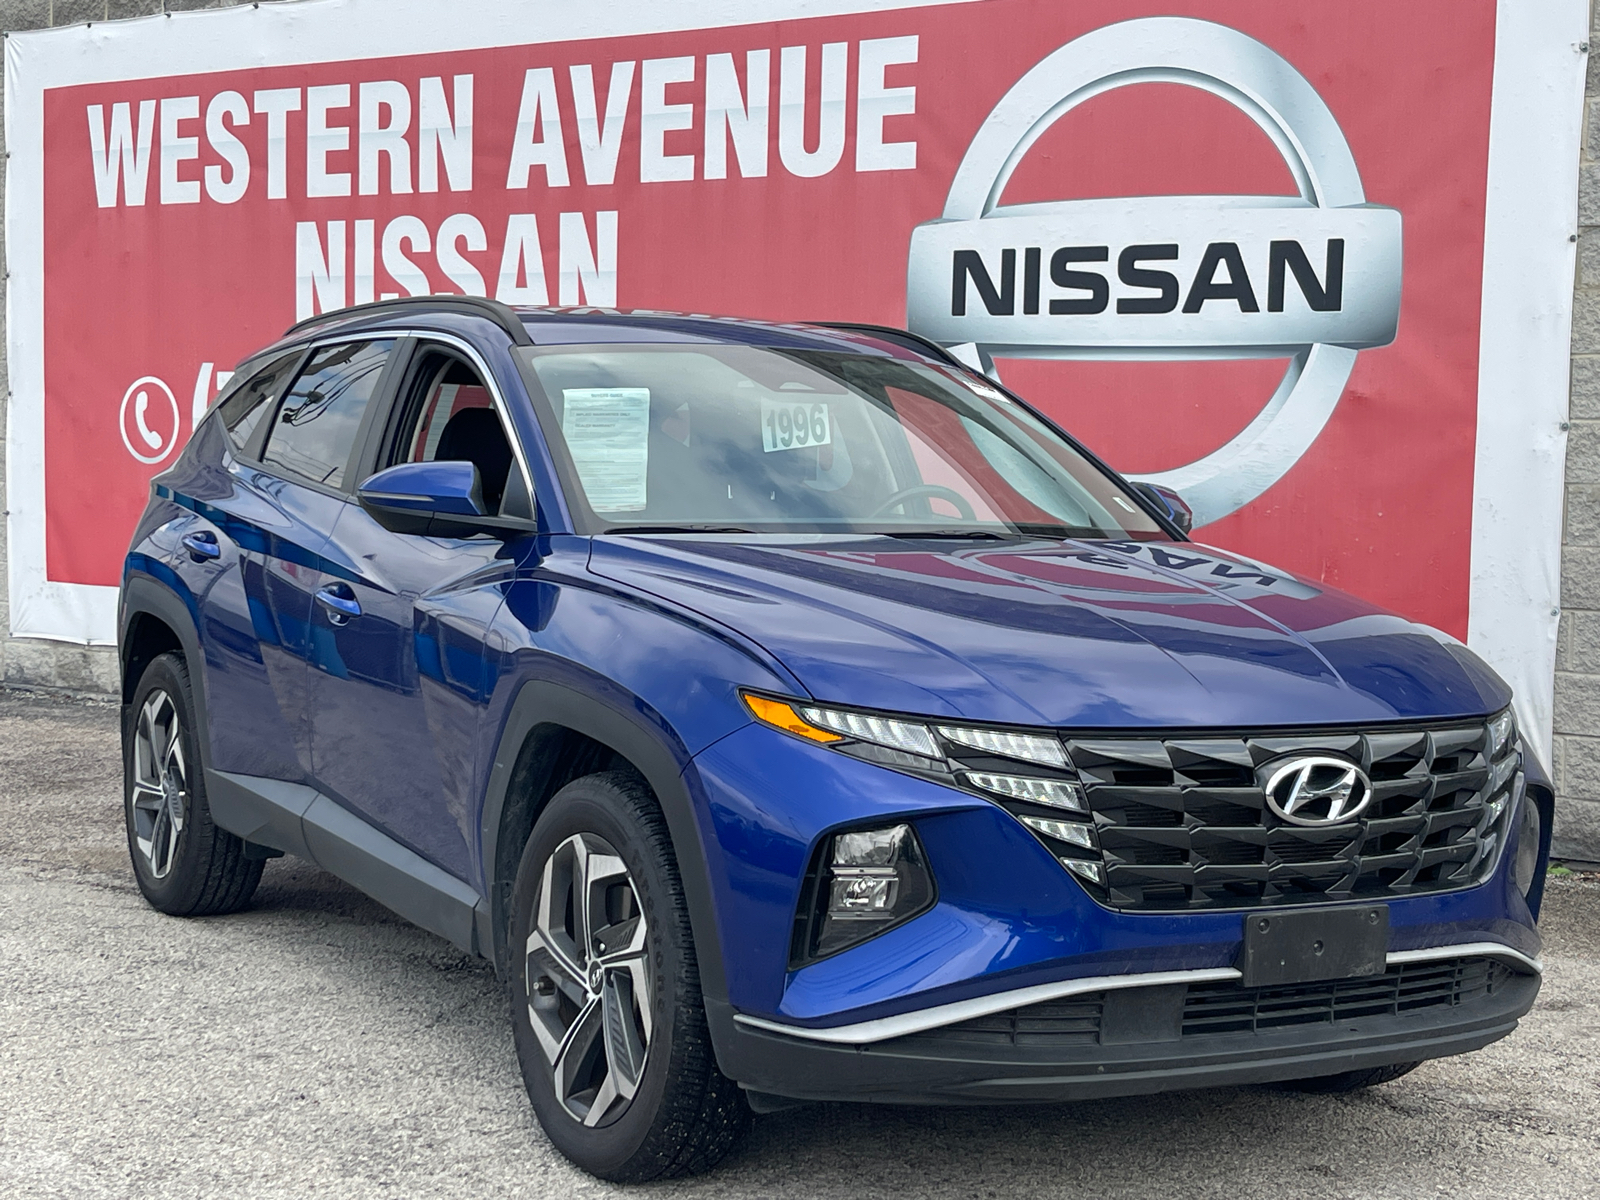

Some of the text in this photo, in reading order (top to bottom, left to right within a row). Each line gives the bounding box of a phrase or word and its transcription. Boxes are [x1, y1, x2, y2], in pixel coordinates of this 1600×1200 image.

[86, 34, 920, 208] WESTERN AVENUE
[295, 210, 619, 324] NISSAN
[951, 237, 1345, 317] NISSAN
[766, 402, 827, 449] 1996
